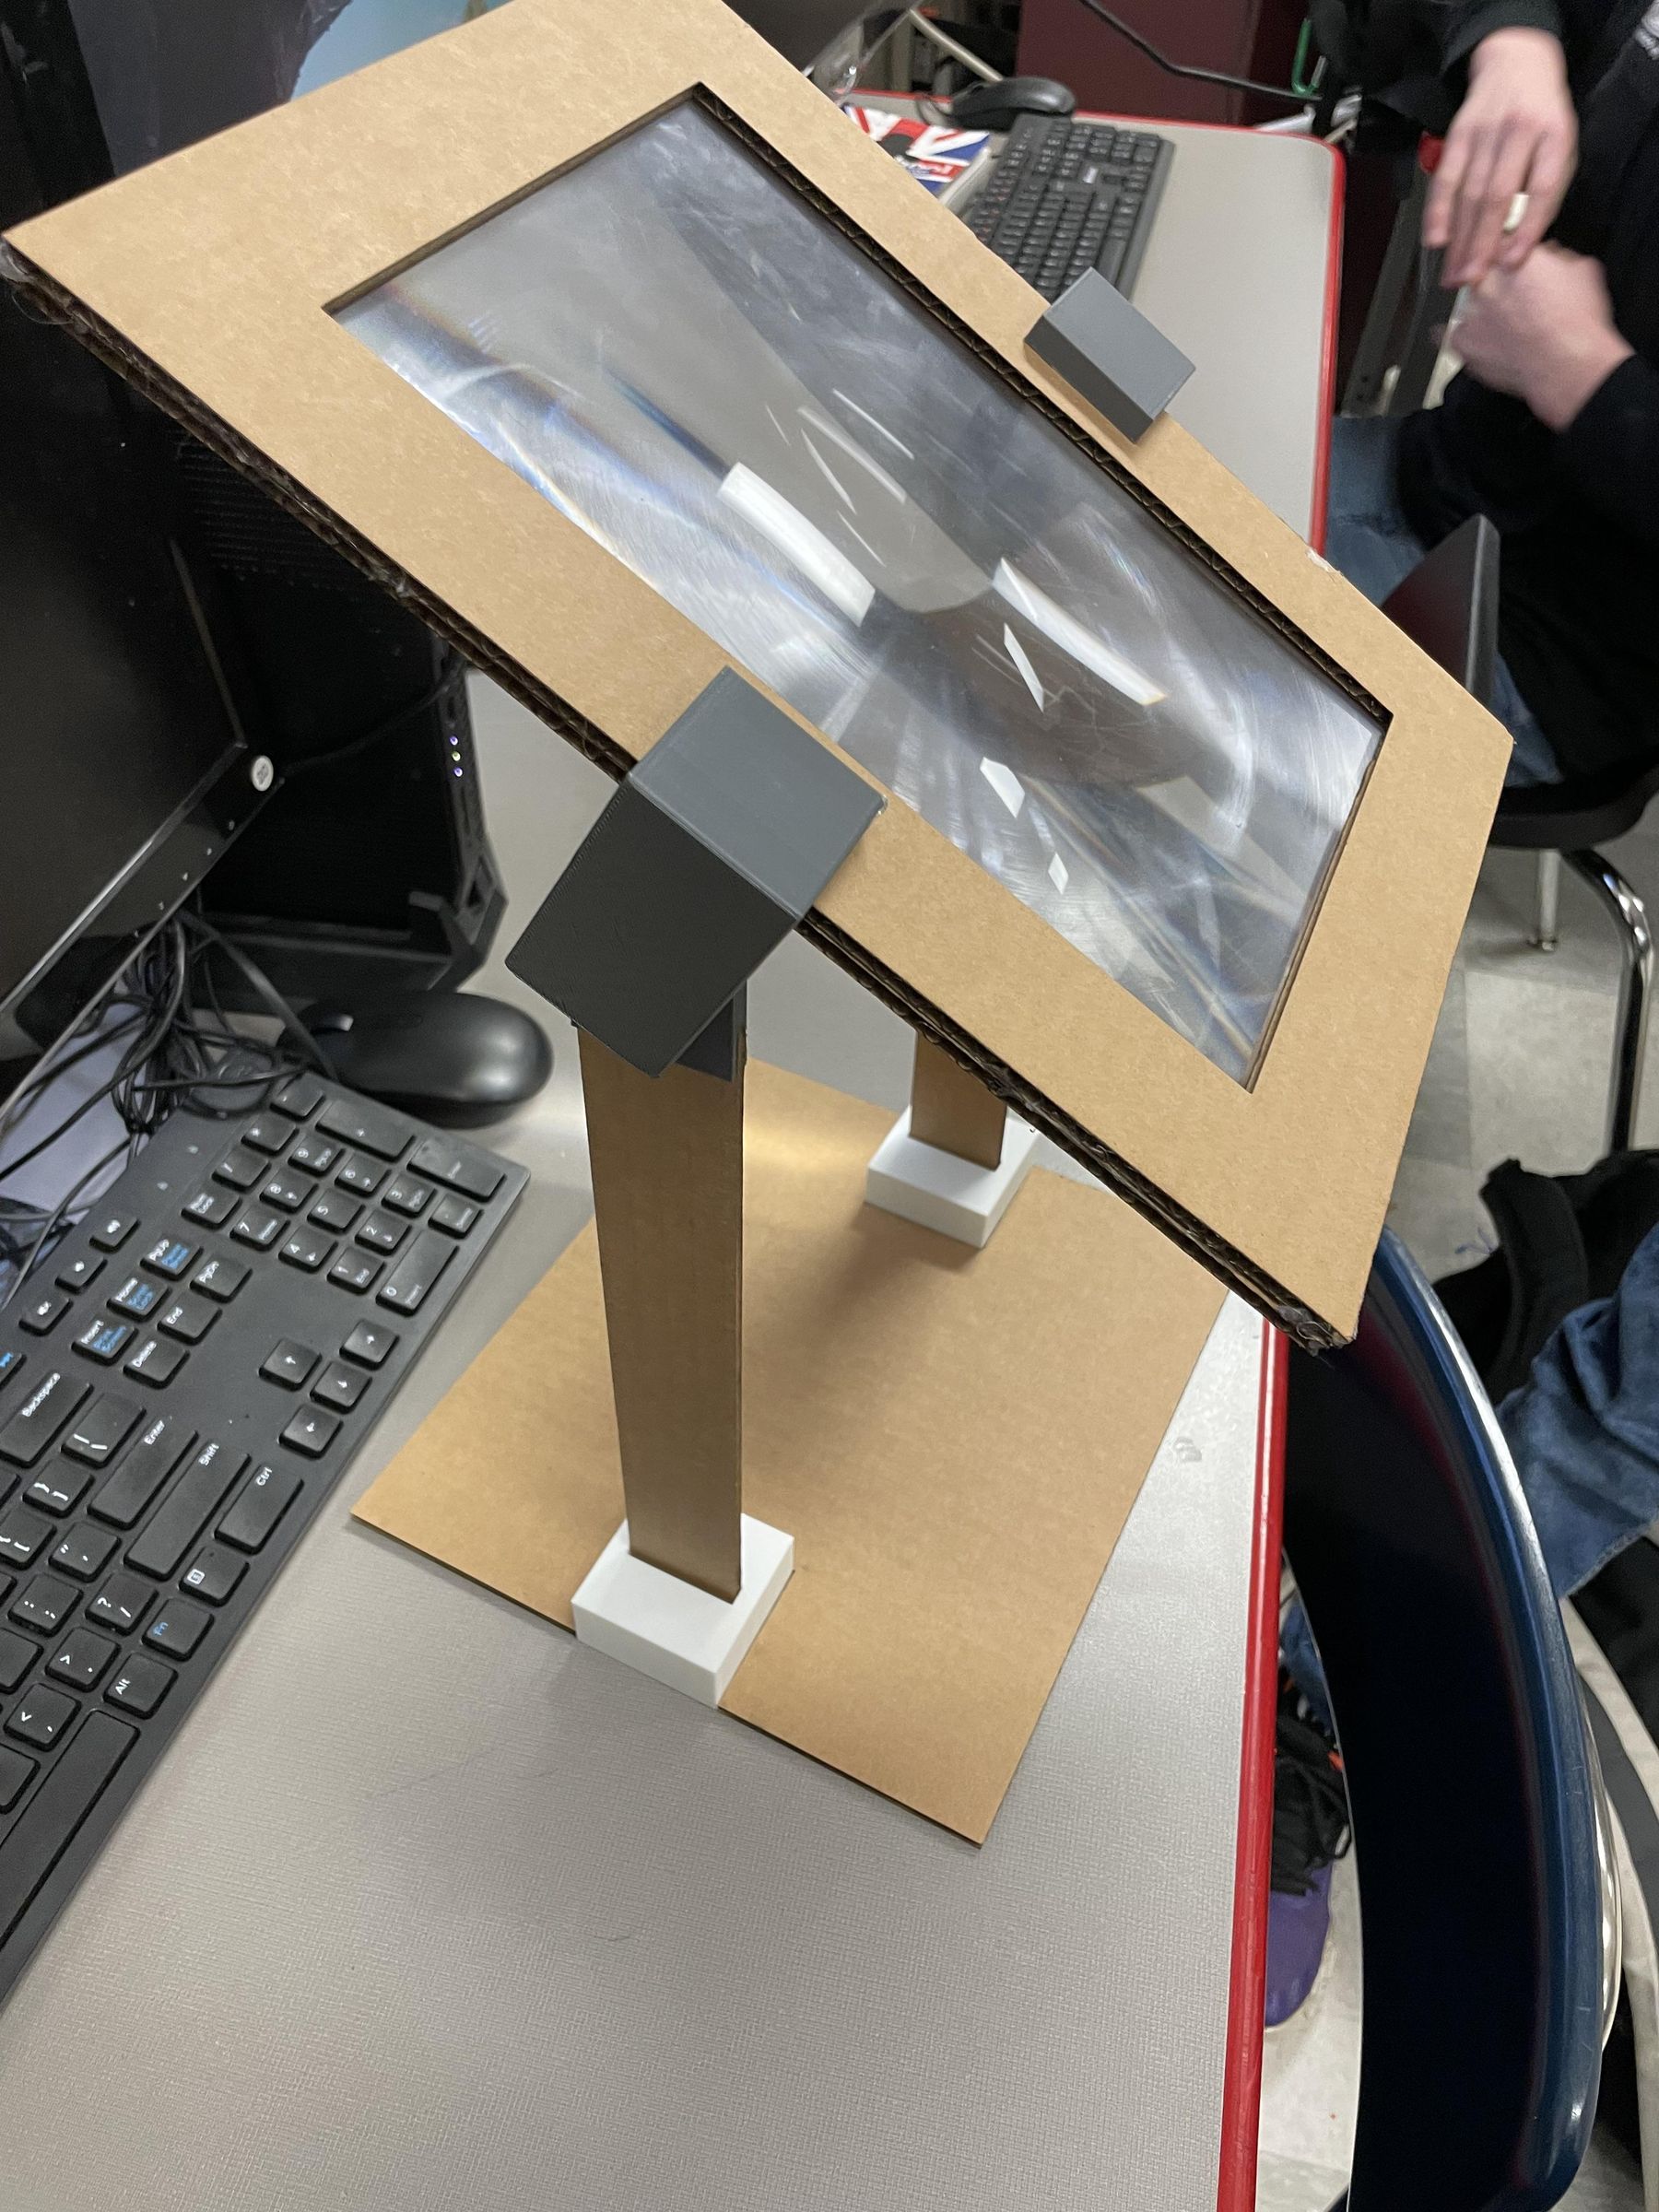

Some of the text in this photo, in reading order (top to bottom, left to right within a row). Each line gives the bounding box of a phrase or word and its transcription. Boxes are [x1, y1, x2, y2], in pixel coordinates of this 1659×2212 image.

[298, 1147, 309, 1159] 9
[345, 1170, 357, 1180] 6
[391, 1190, 403, 1200] 3
[317, 1206, 329, 1216] 5
[240, 1221, 250, 1232] 7
[365, 1226, 378, 1236] 2
[289, 1244, 301, 1254] 4
[336, 1265, 349, 1274] 1
[386, 1287, 397, 1297] 0
[166, 1306, 183, 1325] End
[144, 1419, 165, 1445] Enter
[198, 1442, 220, 1466] Shift
[255, 1466, 274, 1487] Ctrl
[97, 1596, 112, 1608] ?
[152, 1621, 169, 1637] Fn
[114, 1677, 132, 1696] Alt
